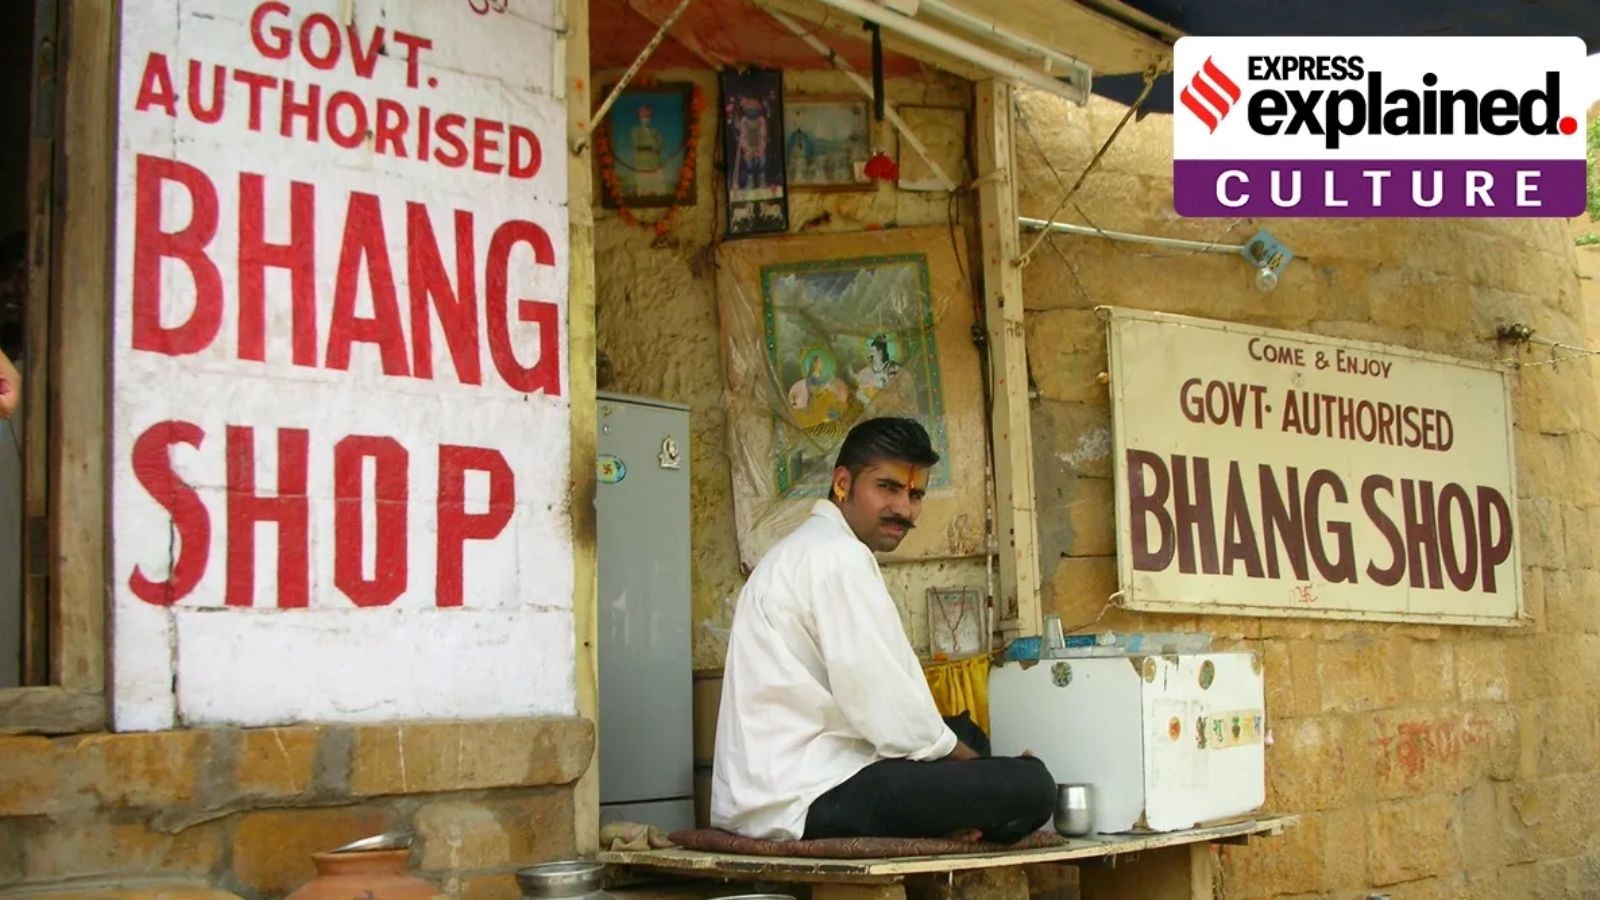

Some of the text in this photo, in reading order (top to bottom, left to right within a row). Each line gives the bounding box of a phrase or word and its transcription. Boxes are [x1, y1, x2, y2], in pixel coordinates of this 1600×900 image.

[250, 1, 438, 88] GOVT.
[135, 52, 542, 179] AUTHORISED
[132, 154, 561, 396] BHANG
[1281, 390, 1454, 452] AUTHORISED
[1315, 351, 1329, 369] &
[128, 420, 515, 608] SHOP
[1126, 449, 1513, 593] BHANG SHOP
